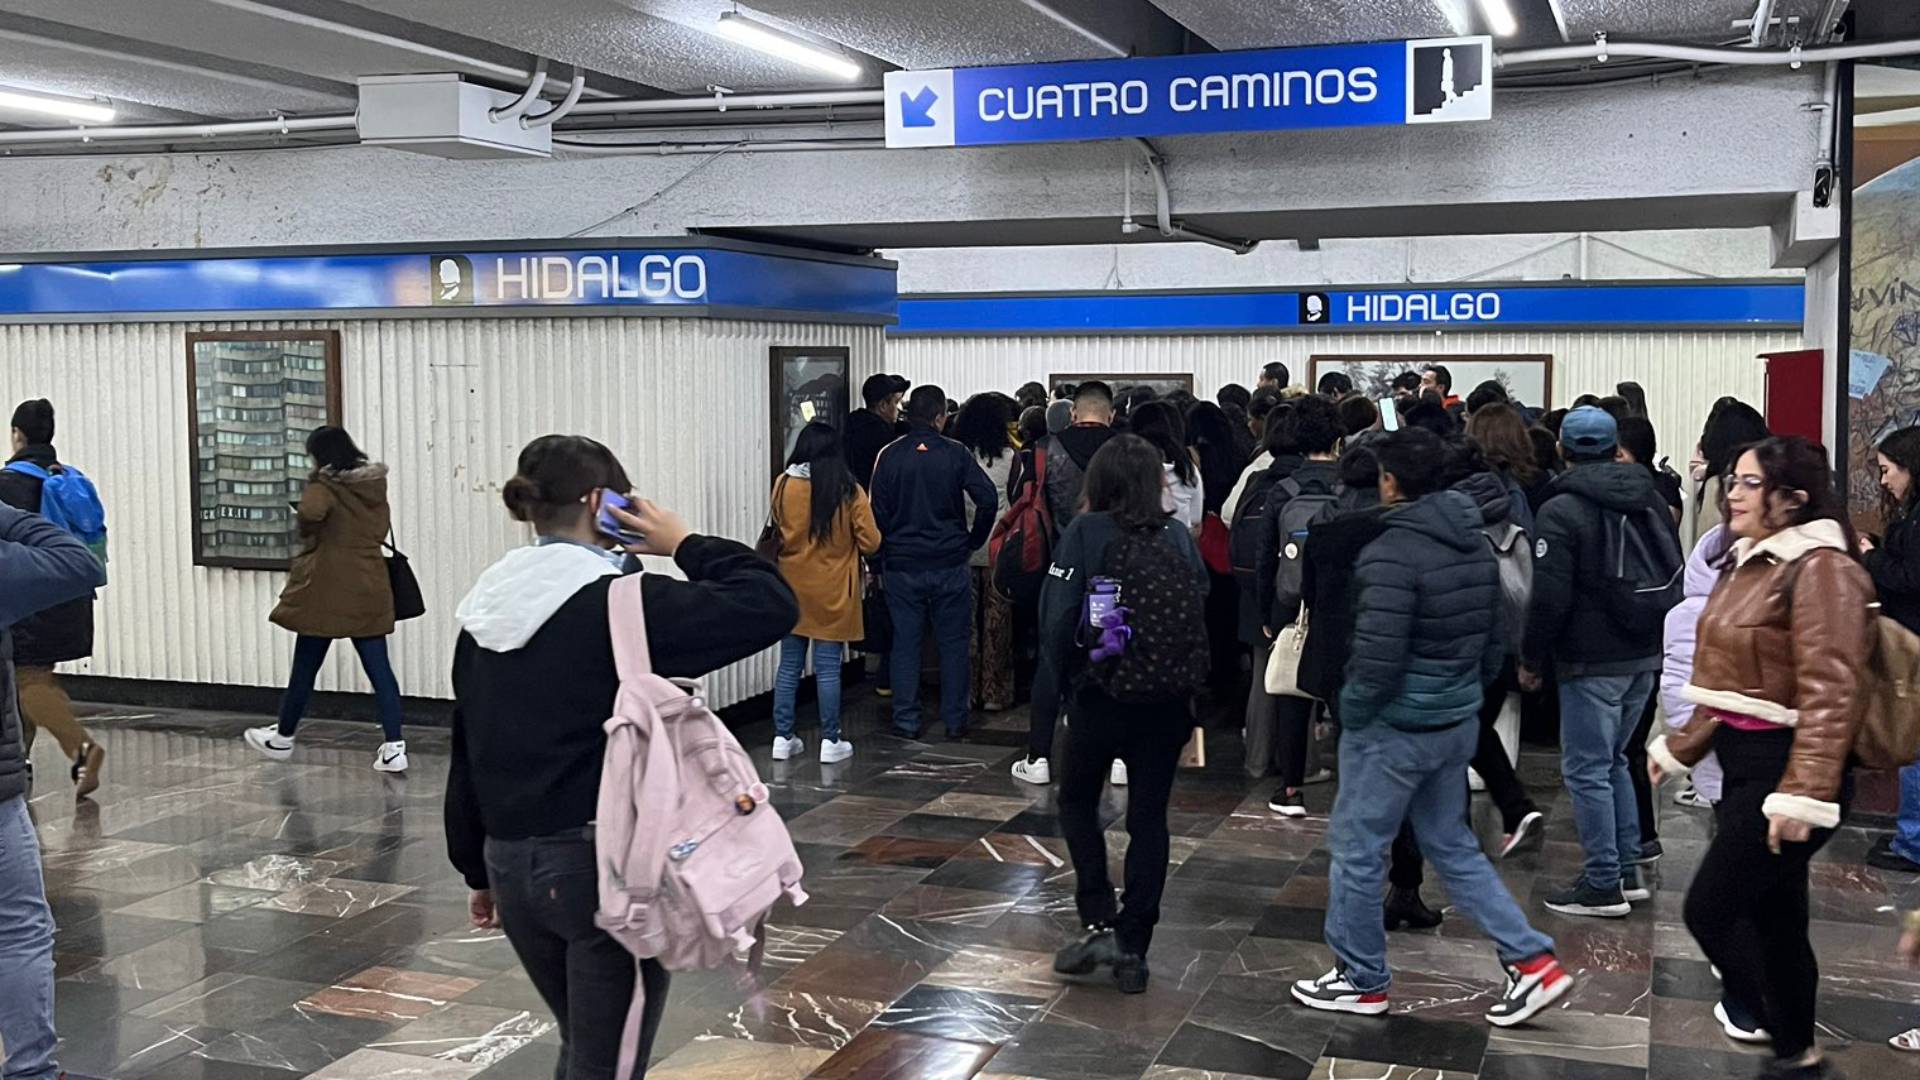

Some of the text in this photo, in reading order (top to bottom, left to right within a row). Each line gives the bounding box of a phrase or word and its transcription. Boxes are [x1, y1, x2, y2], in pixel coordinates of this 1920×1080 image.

[978, 66, 1378, 122] CUATRO CAMINOS
[497, 254, 707, 299] HIDALGO
[1347, 292, 1500, 321] HIDALGO
